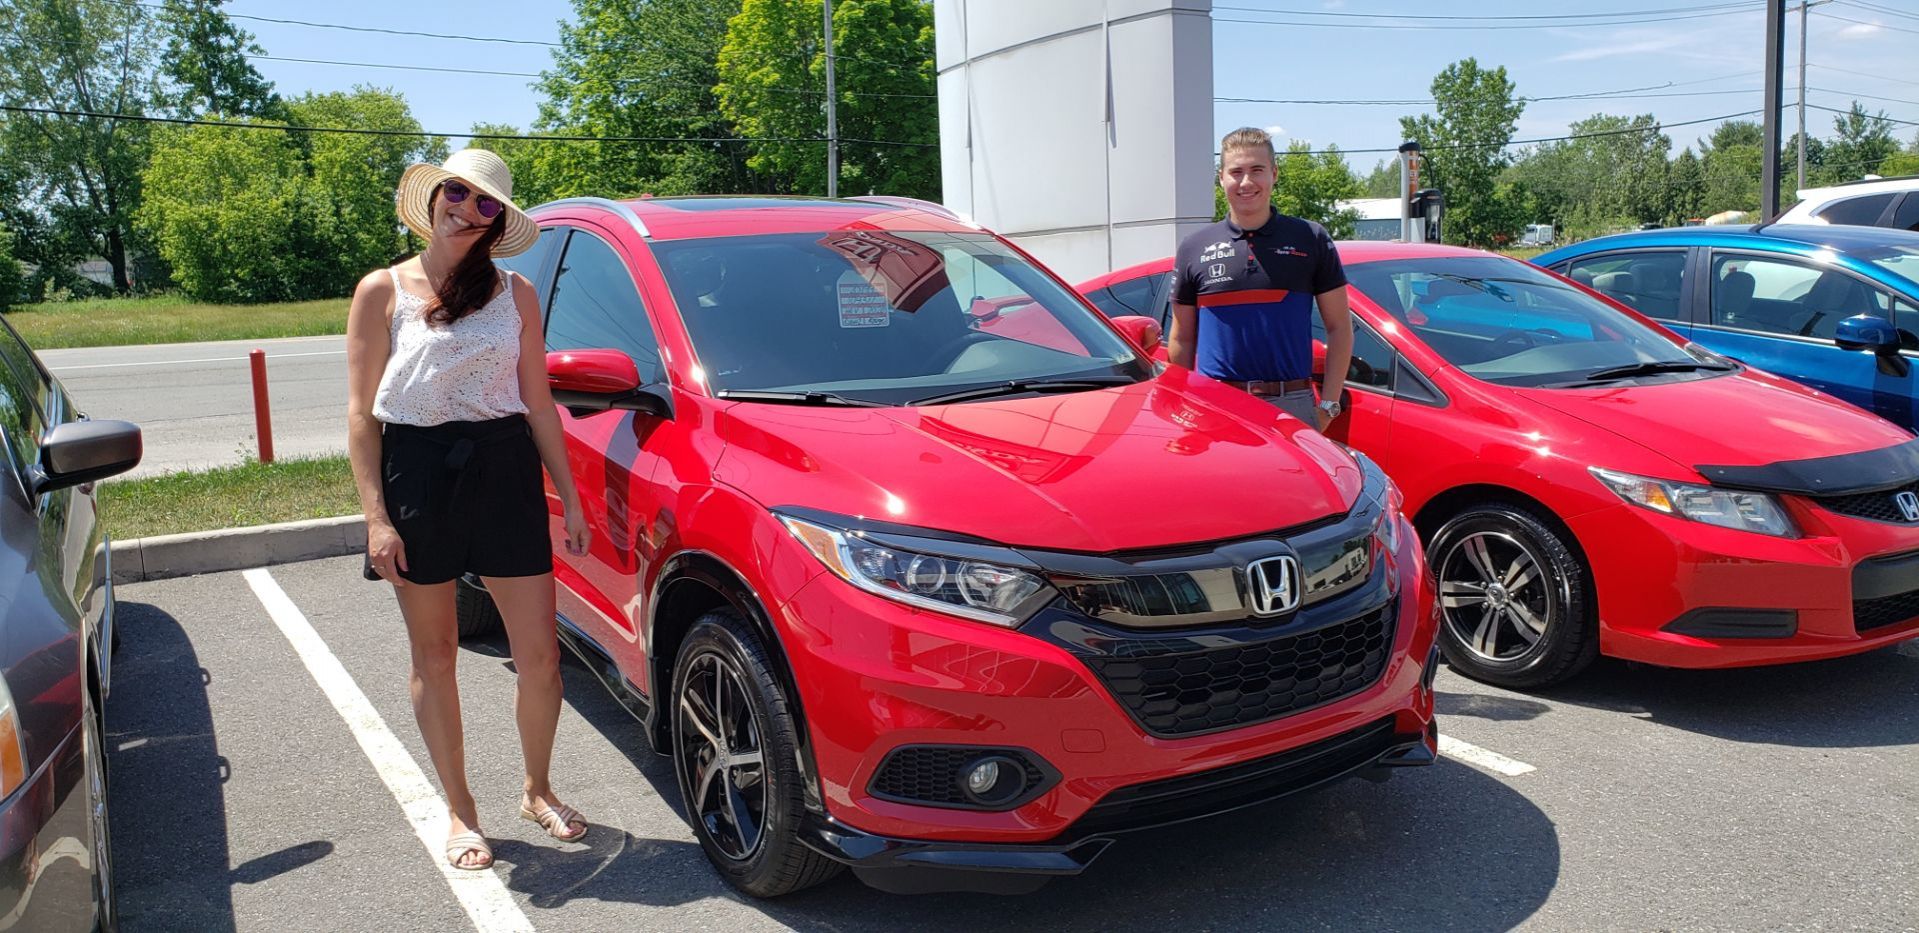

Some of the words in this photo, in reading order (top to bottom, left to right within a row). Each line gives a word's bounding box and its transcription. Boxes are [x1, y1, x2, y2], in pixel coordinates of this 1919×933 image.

[1200, 251, 1217, 263] Red
[1217, 249, 1236, 259] Bull
[1204, 277, 1233, 285] HONDA
